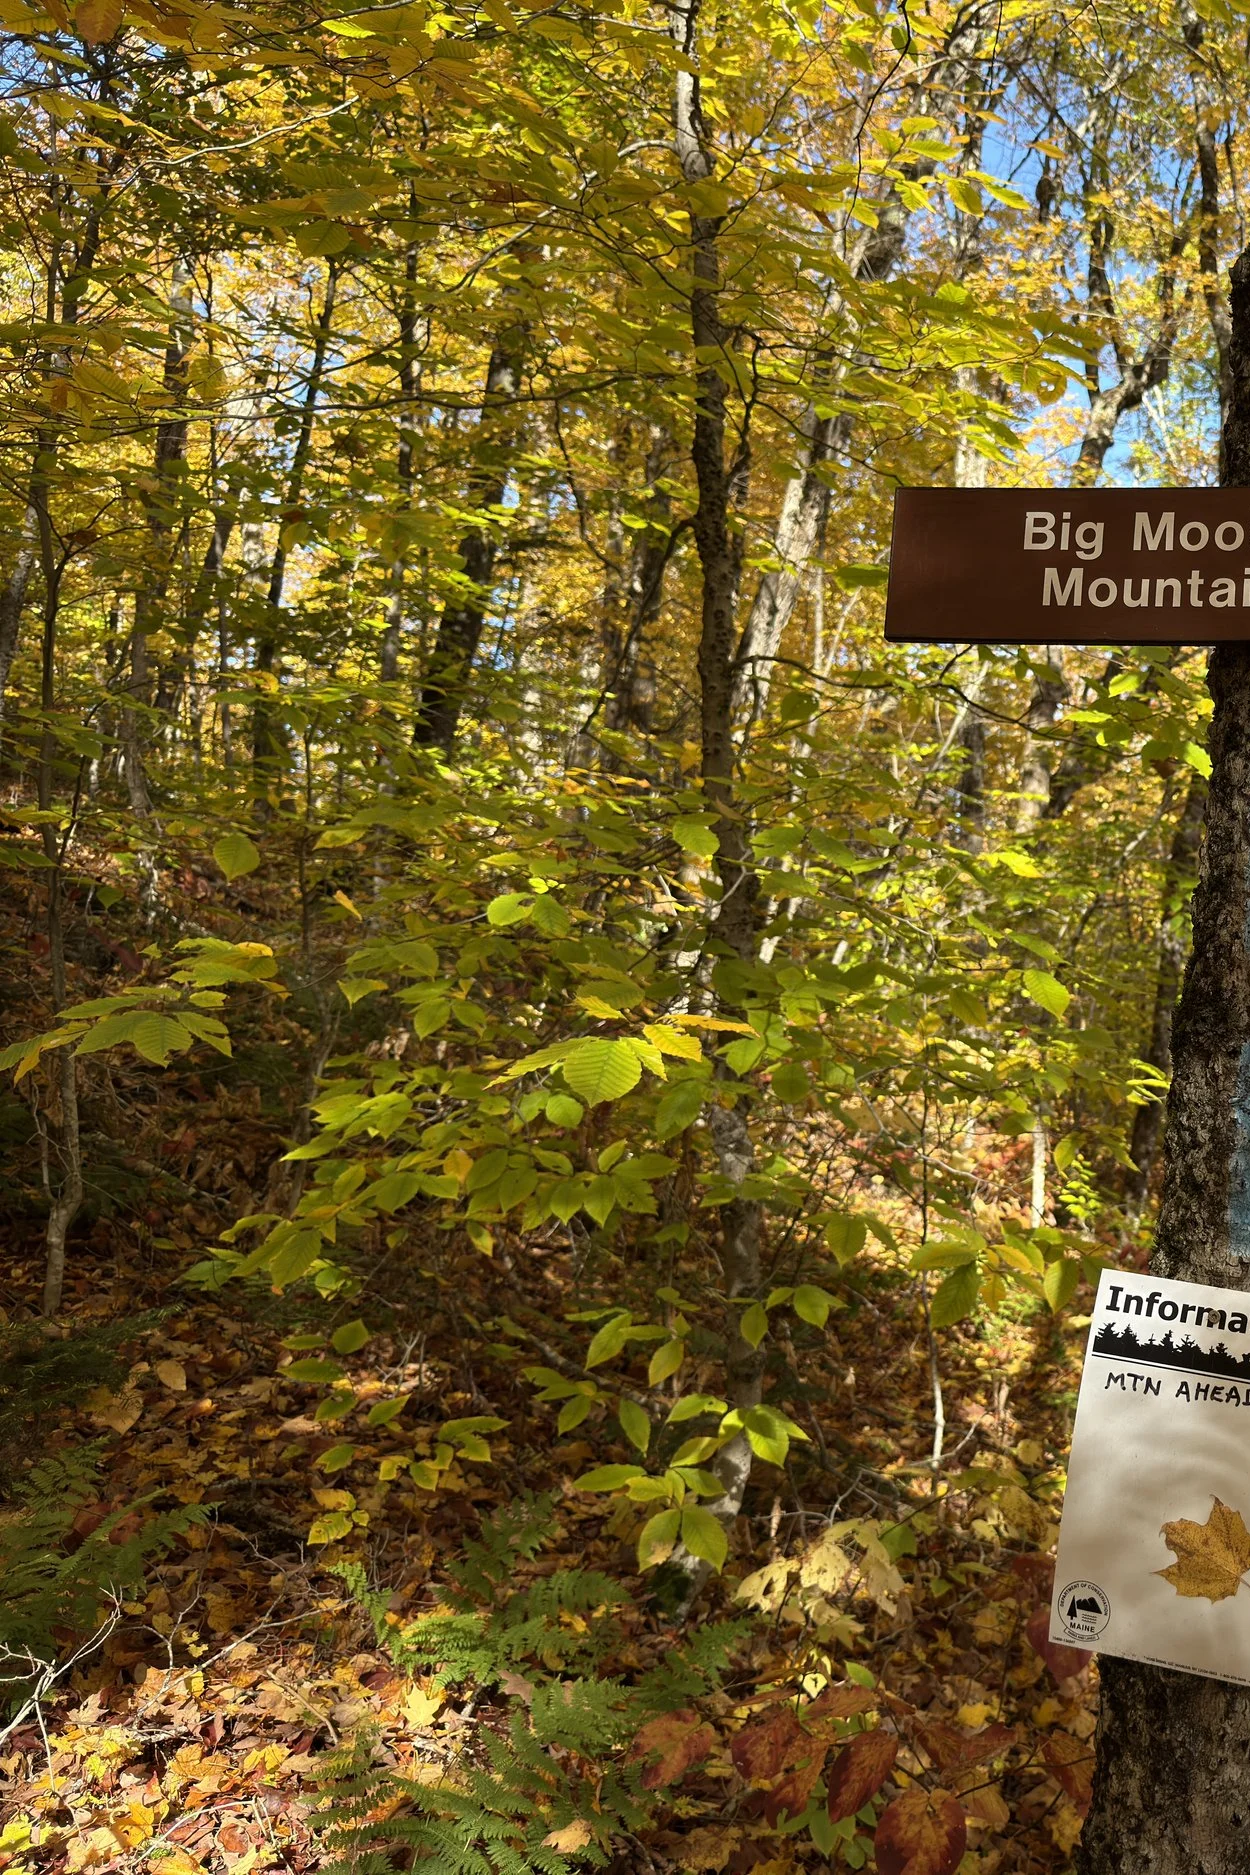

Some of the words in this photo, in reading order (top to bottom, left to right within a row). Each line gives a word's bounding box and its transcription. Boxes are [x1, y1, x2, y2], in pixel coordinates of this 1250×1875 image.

[1023, 511, 1105, 560] Big
[1104, 1372, 1161, 1396] MTN
[1060, 1583, 1080, 1607] DEPARTMENT
[1087, 1584, 1108, 1616] CONSERVATION
[1070, 1622, 1095, 1633] MAINE
